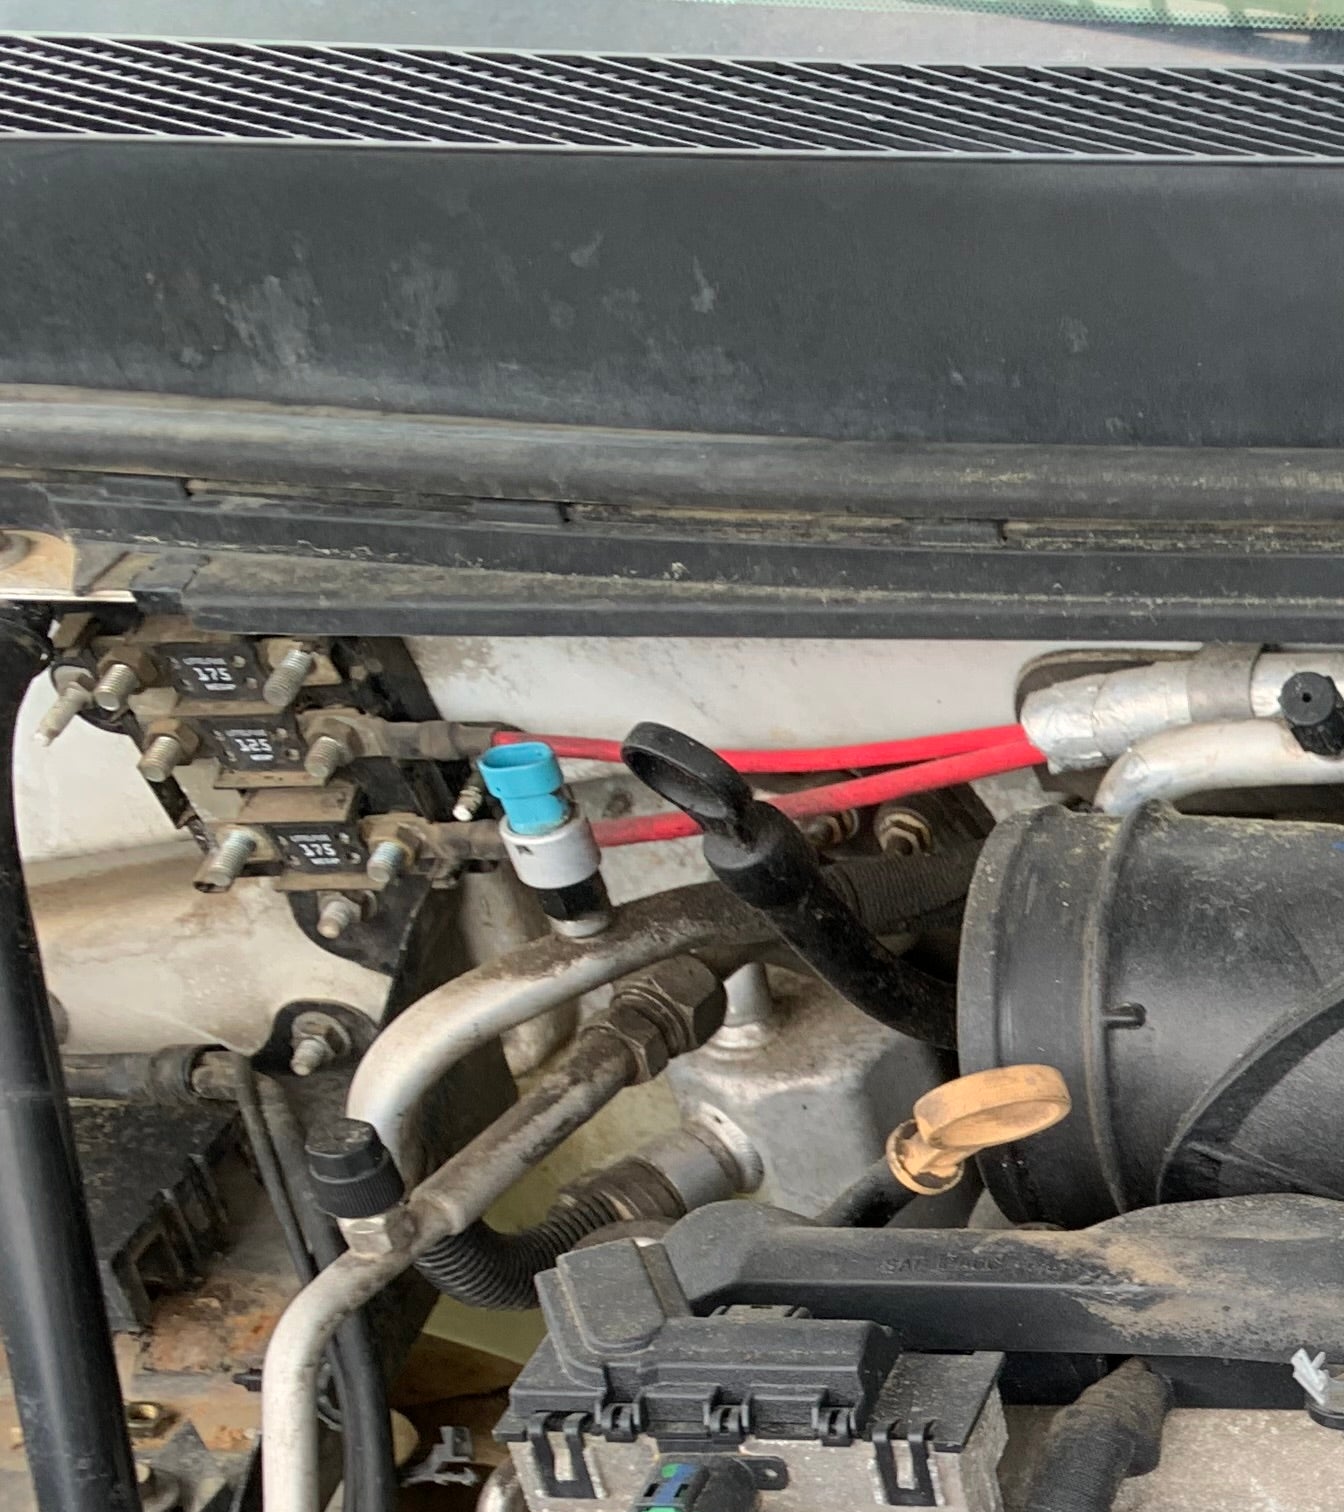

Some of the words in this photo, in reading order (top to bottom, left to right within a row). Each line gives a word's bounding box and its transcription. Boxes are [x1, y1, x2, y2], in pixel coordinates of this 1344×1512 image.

[192, 667, 233, 681] 175
[234, 738, 272, 752] 125
[298, 843, 337, 857] 175
